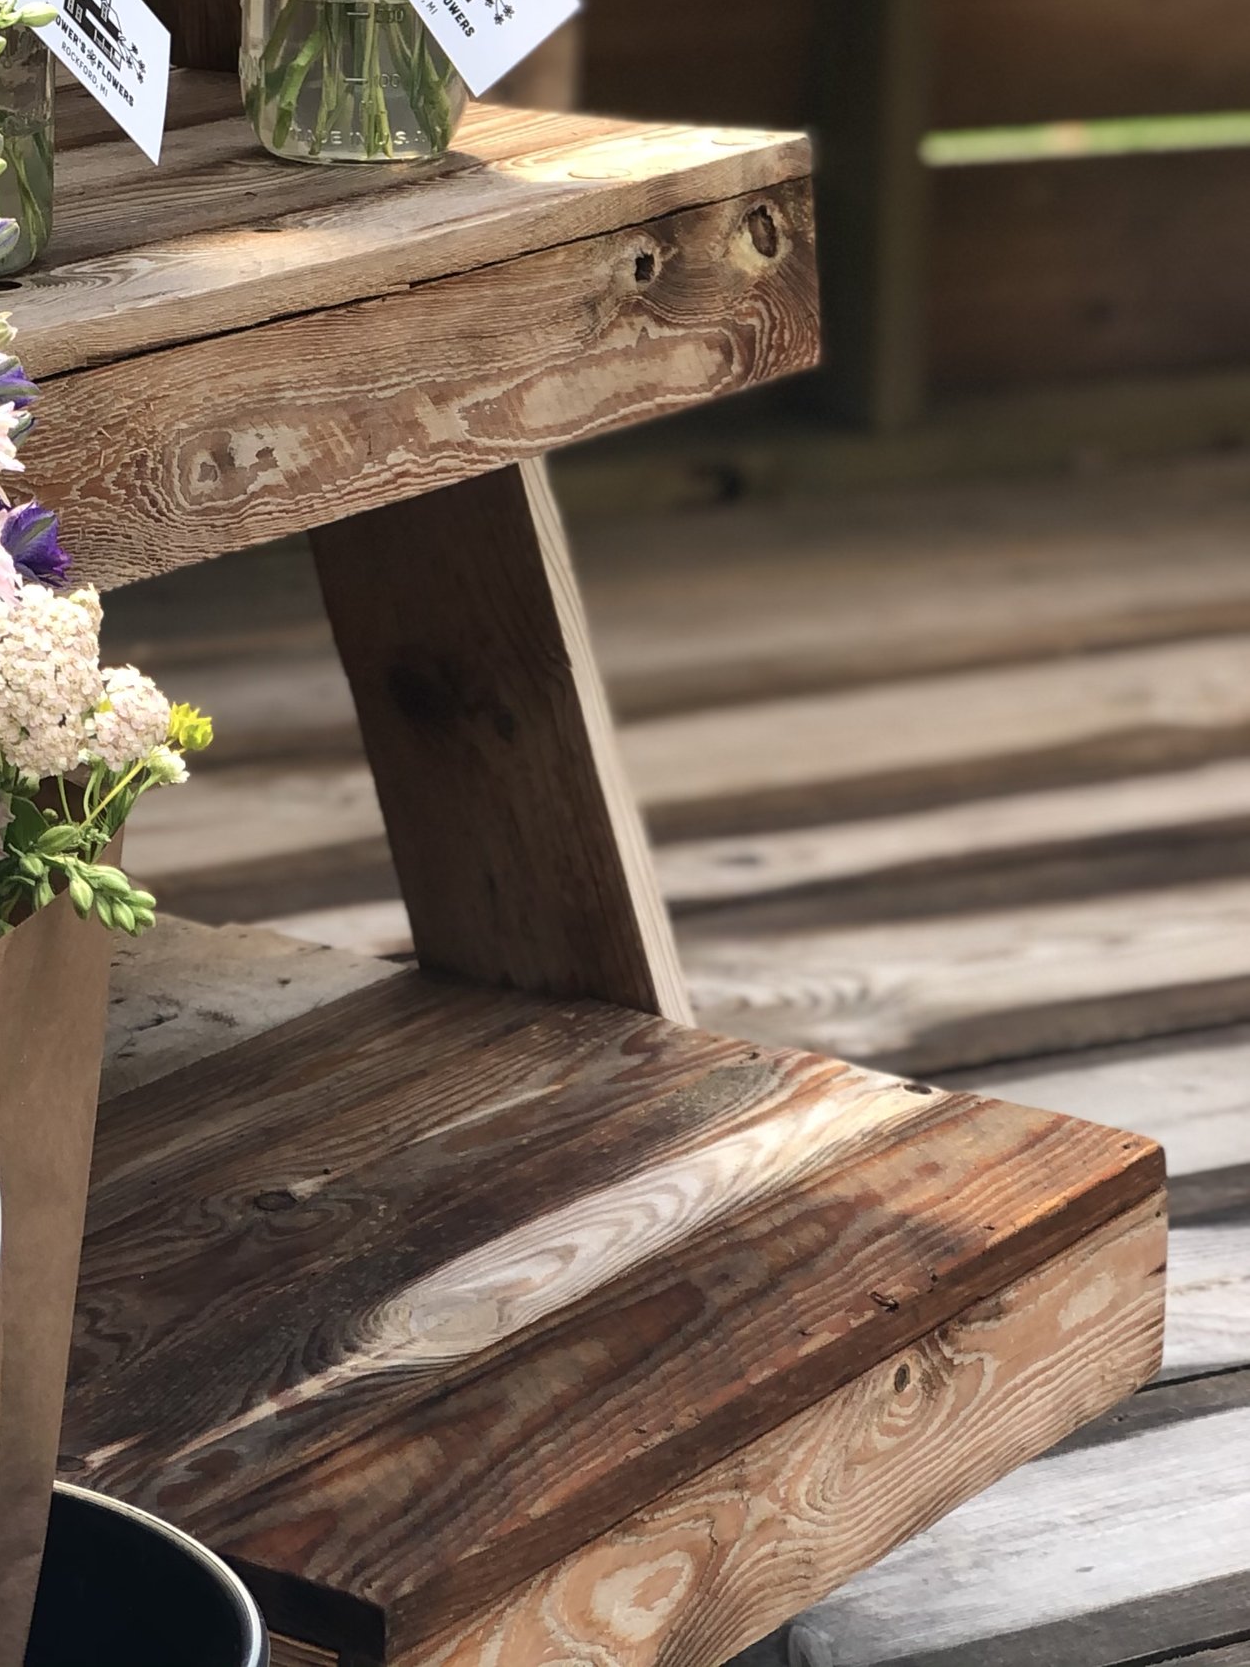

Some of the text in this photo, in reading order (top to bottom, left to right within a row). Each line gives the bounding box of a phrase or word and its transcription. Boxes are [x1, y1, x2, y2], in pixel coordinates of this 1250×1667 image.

[426, 1, 438, 15] MI
[55, 14, 134, 107] OWER'S FLOWERS
